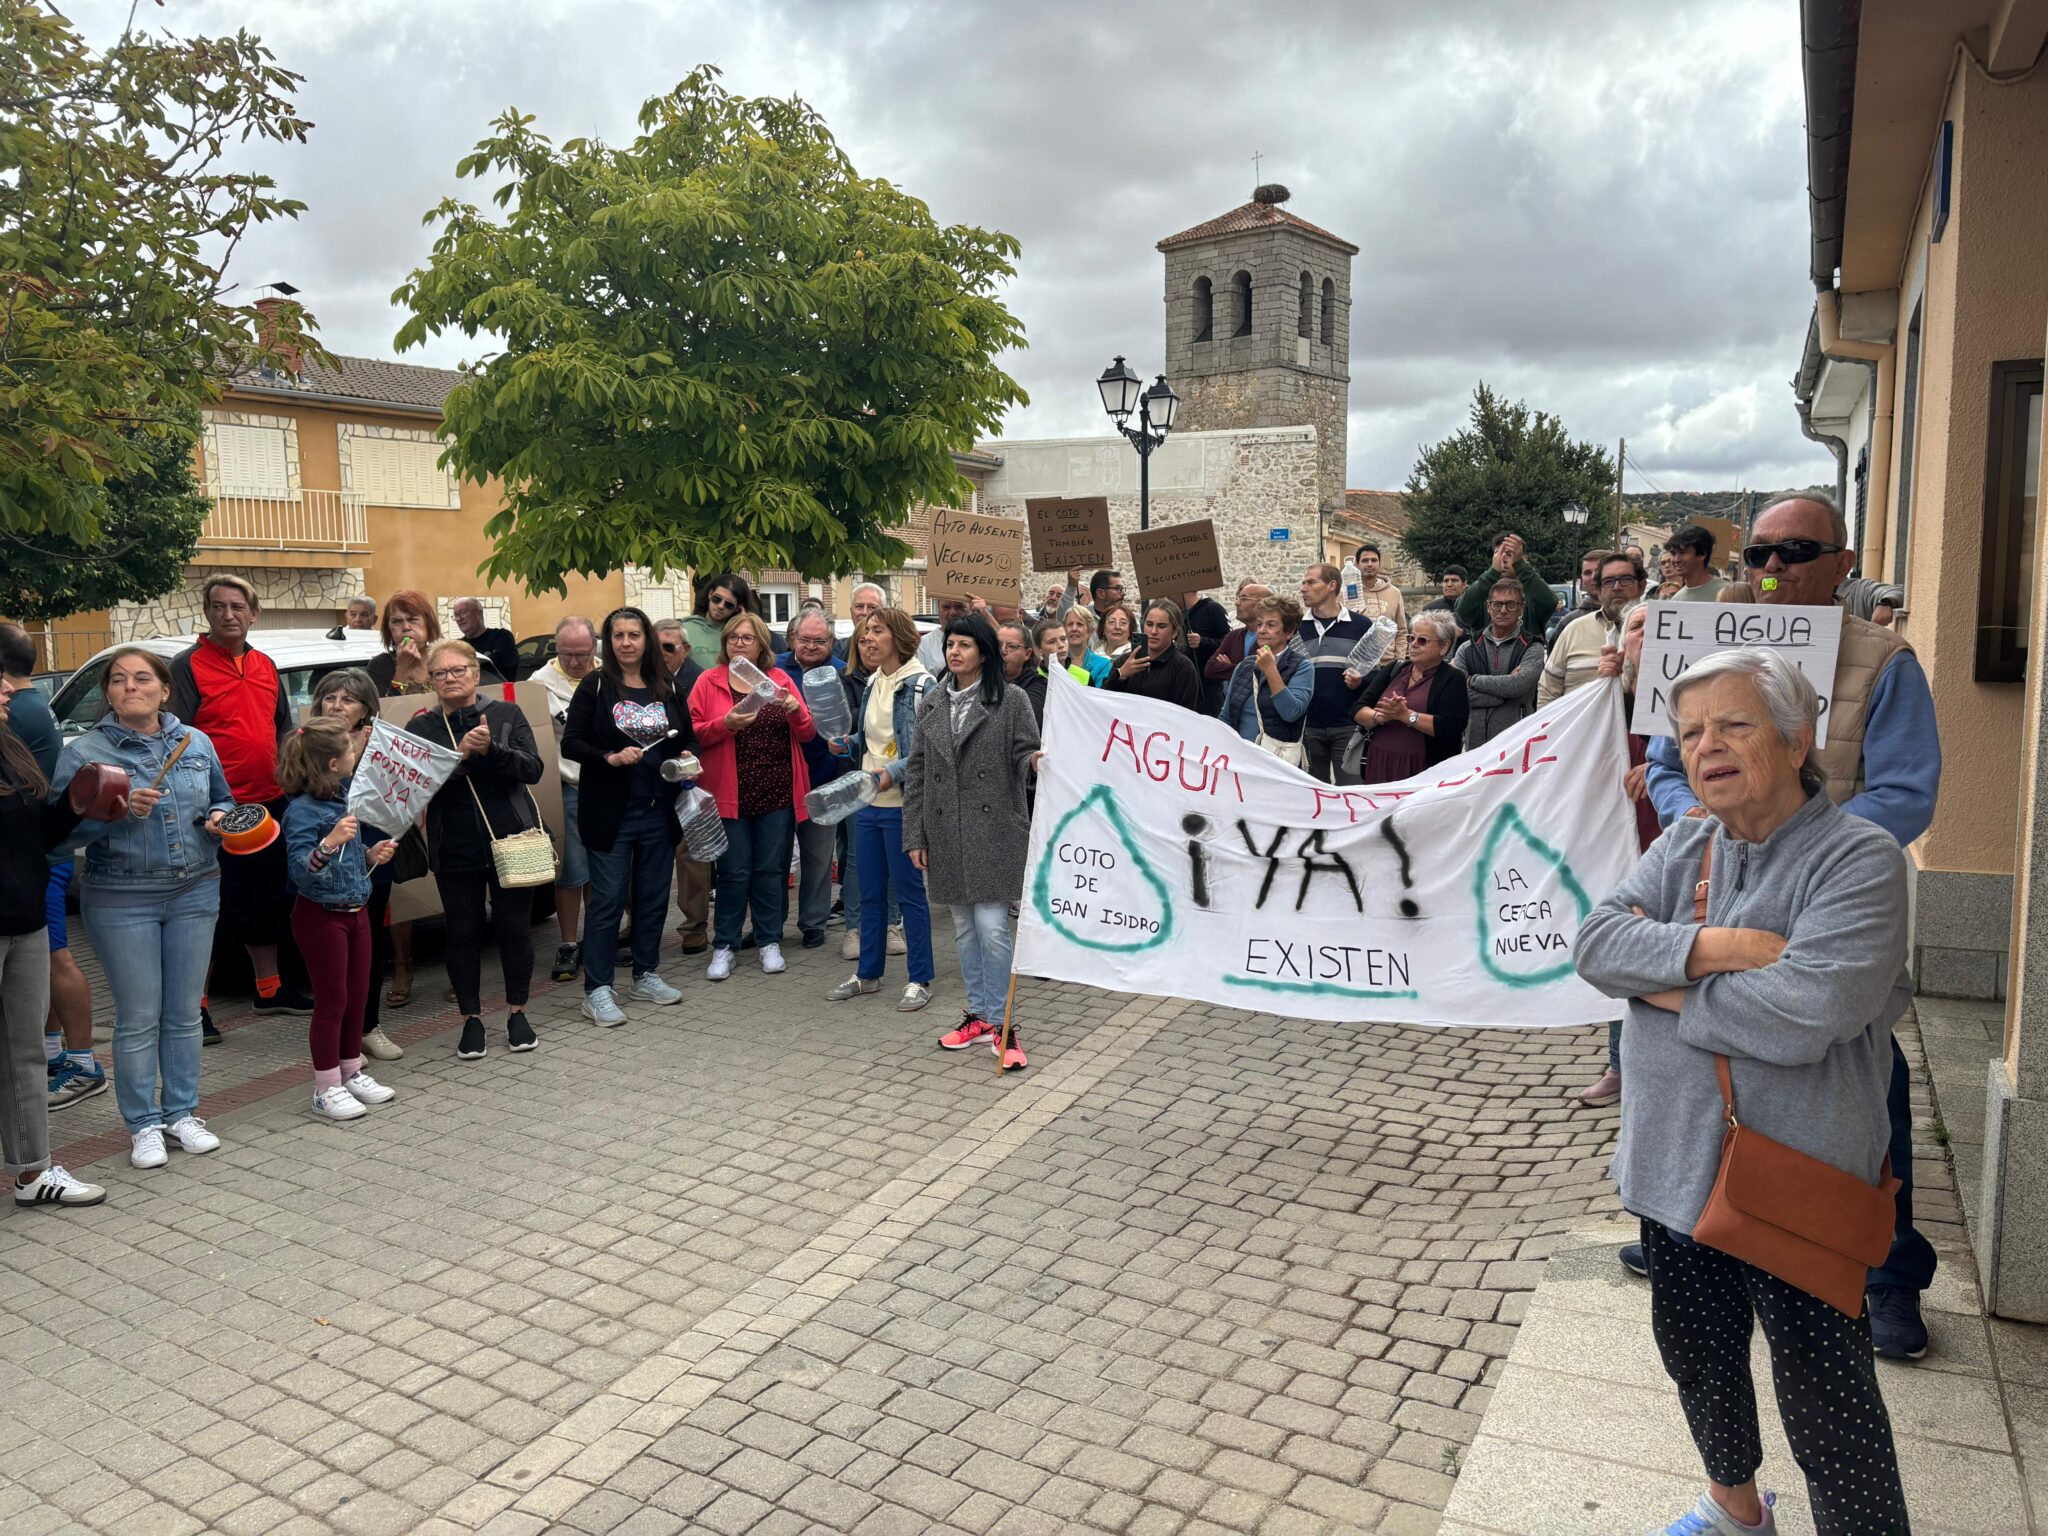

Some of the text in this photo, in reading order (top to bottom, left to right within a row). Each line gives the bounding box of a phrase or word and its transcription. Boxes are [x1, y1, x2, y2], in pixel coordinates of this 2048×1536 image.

[933, 509, 1022, 540] AYTO AUSENTE
[1037, 510, 1049, 519] EL
[1055, 508, 1080, 519] COTO
[932, 541, 993, 567] VECINOS
[1135, 531, 1209, 554] AGUA POTABLE
[1044, 552, 1104, 567] EXISTEN
[1154, 550, 1200, 566] DERECHO
[946, 569, 1018, 589] PRESENTES
[1655, 609, 1812, 644] EL AGUA
[389, 735, 431, 764] AGUA
[1101, 718, 1244, 803] AGUA
[370, 750, 433, 789] POTABLE
[1058, 843, 1115, 869] COTO
[1074, 874, 1098, 893] DE
[1493, 868, 1529, 891] LA
[1051, 898, 1160, 934] SAN ISIDRO
[1495, 933, 1568, 956] NUEVA
[1246, 938, 1410, 986] EXISTEN
